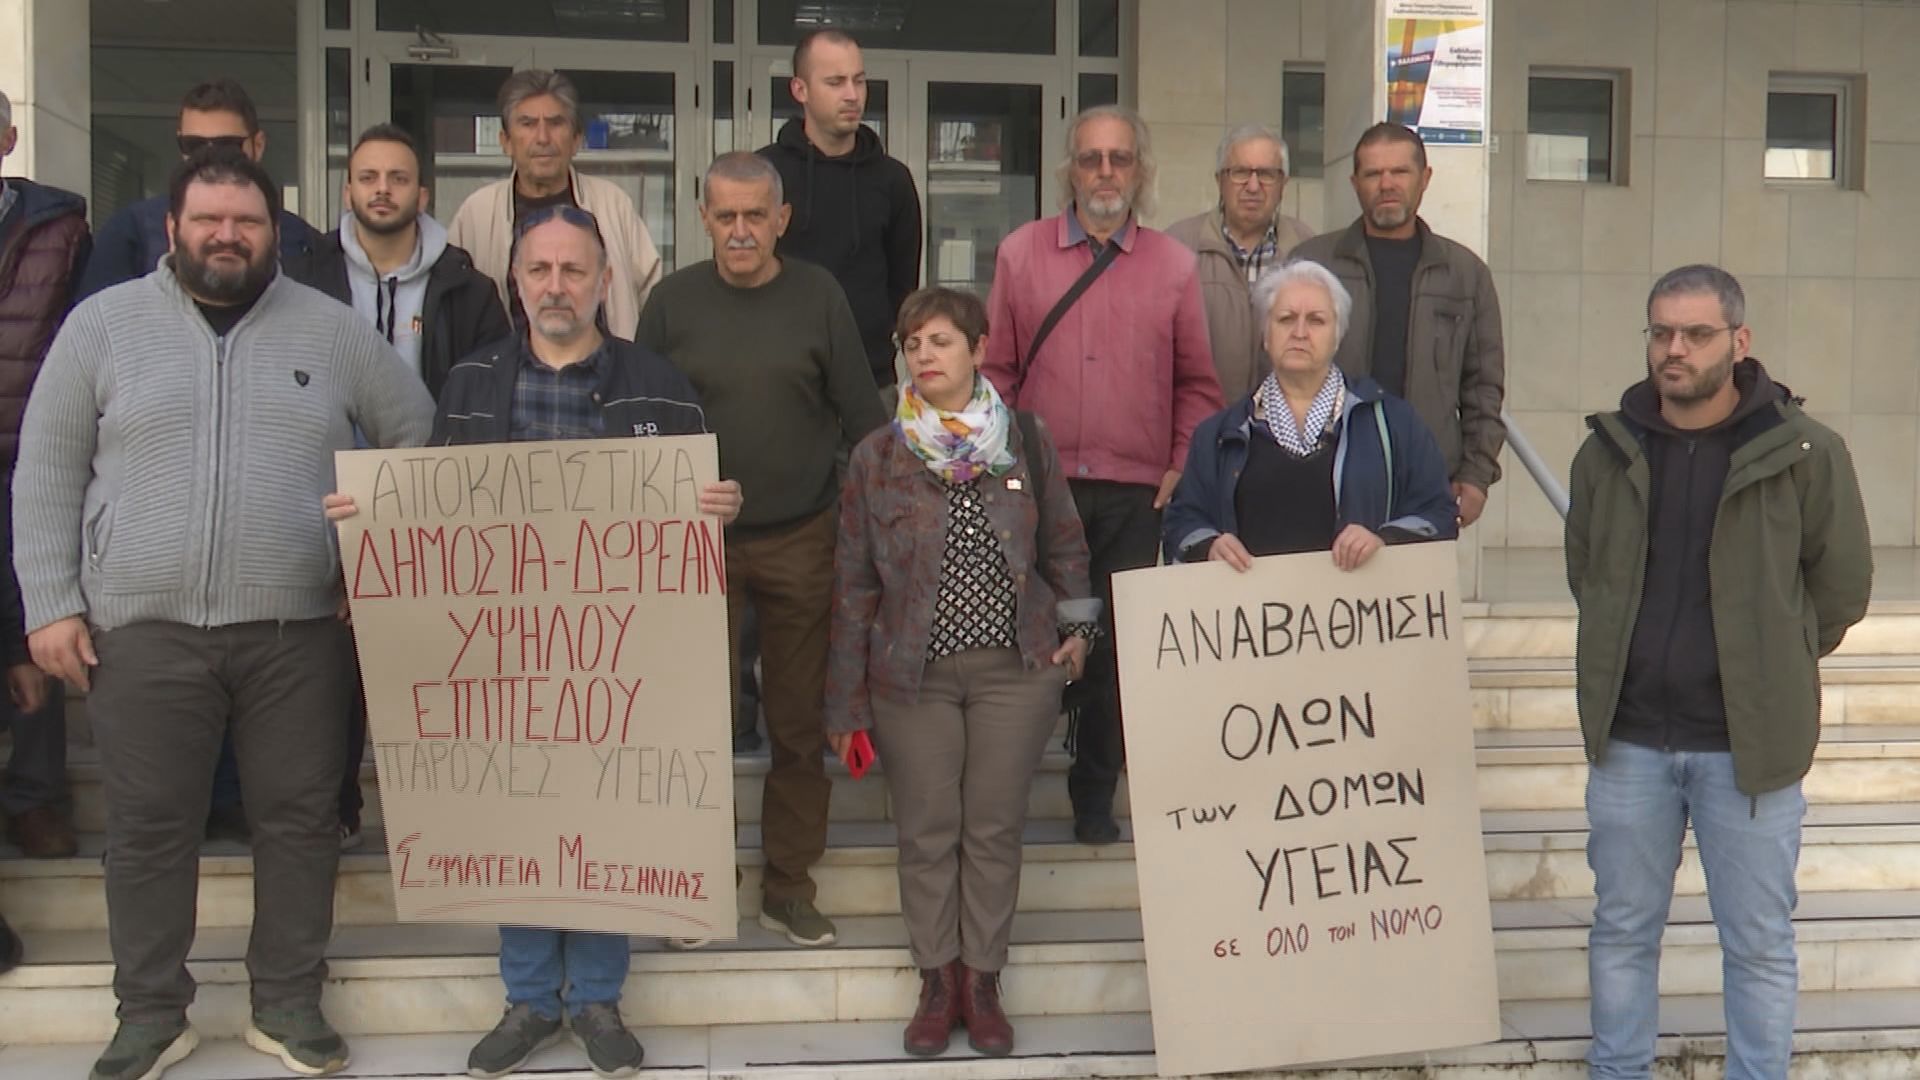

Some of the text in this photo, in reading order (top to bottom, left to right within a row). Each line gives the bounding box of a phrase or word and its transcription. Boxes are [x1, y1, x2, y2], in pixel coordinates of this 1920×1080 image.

[372, 448, 698, 521] ΑΠΟΚΛΕΙΣΤΙΚΑ
[448, 604, 636, 678] ΥΨΗΛΟΥ
[1157, 590, 1449, 669] ΑΝΑΒΑΘΜΙΣΗ
[412, 676, 643, 744] ΕΠΙΠΕΔΟΥ
[1221, 692, 1376, 761] ΟΛΩΝ
[376, 742, 721, 810] ΠΑΡΟΧΕΣ ΥΓΕΙΑΣ
[1274, 768, 1425, 821] ΔΟΜΩΝ
[395, 832, 709, 902] ΣΩΜΑΤΕΙΑ ΜΕΣΣΗΝΙΑΣ
[1246, 836, 1424, 913] ΥΓΕΙΑΣ
[1266, 922, 1310, 957] ΟΛΟ
[1370, 904, 1443, 942] ΝΟΜΟ
